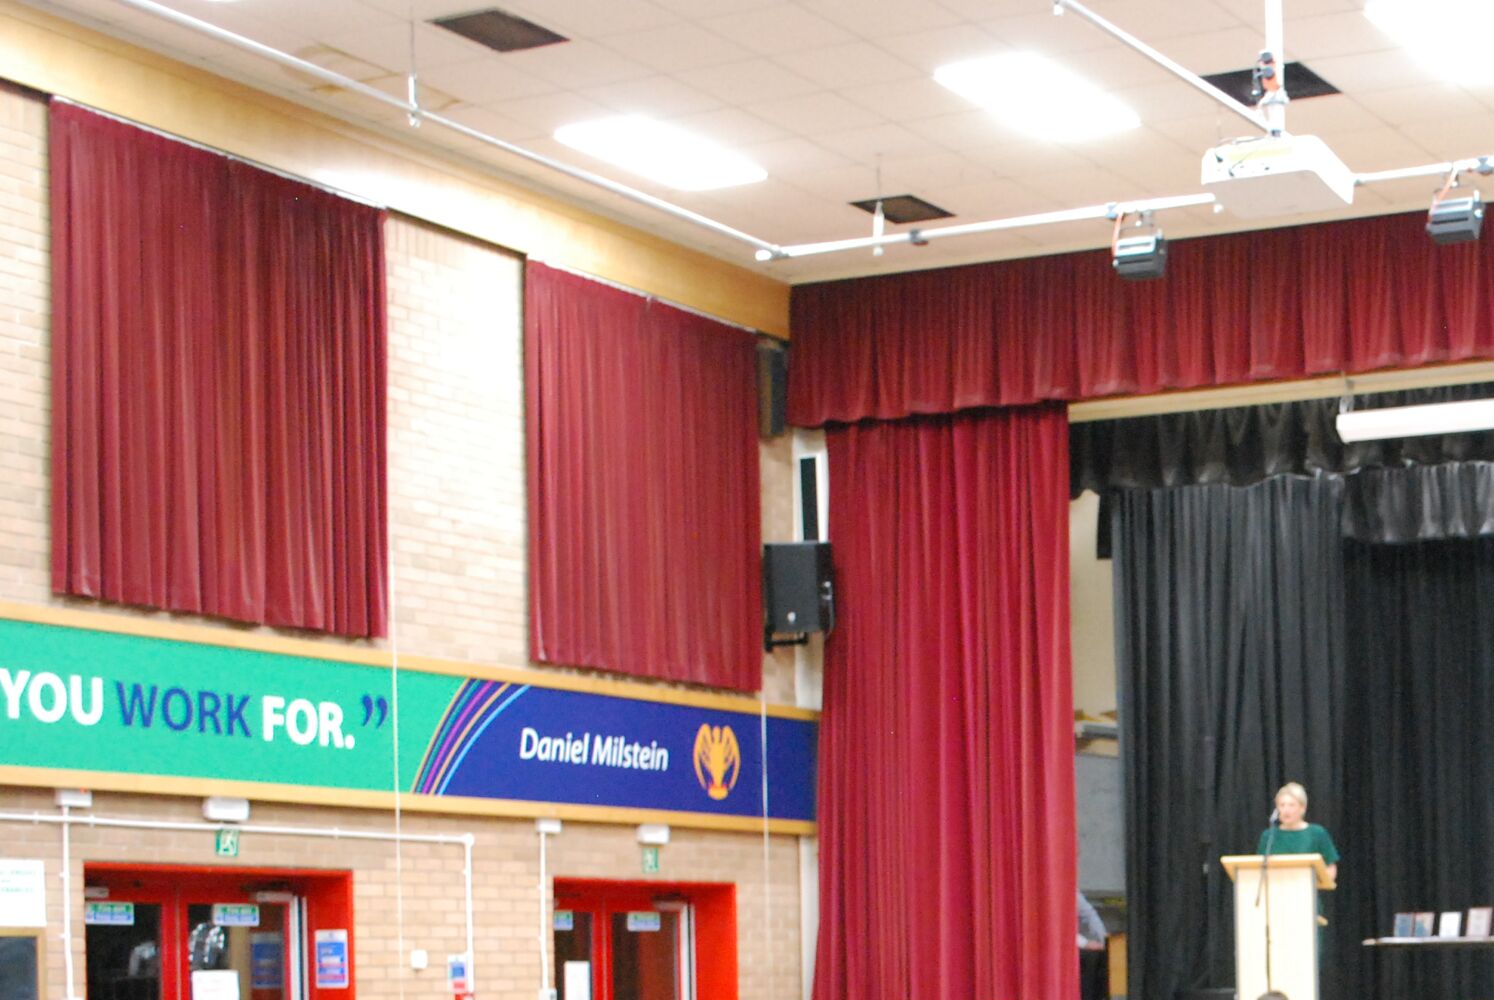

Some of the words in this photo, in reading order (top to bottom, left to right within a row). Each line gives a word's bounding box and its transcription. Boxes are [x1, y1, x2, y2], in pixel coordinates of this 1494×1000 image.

[0, 668, 104, 726] YOU
[115, 680, 252, 738] WORK
[519, 726, 590, 766] Daniel
[591, 734, 669, 772] Milstein
